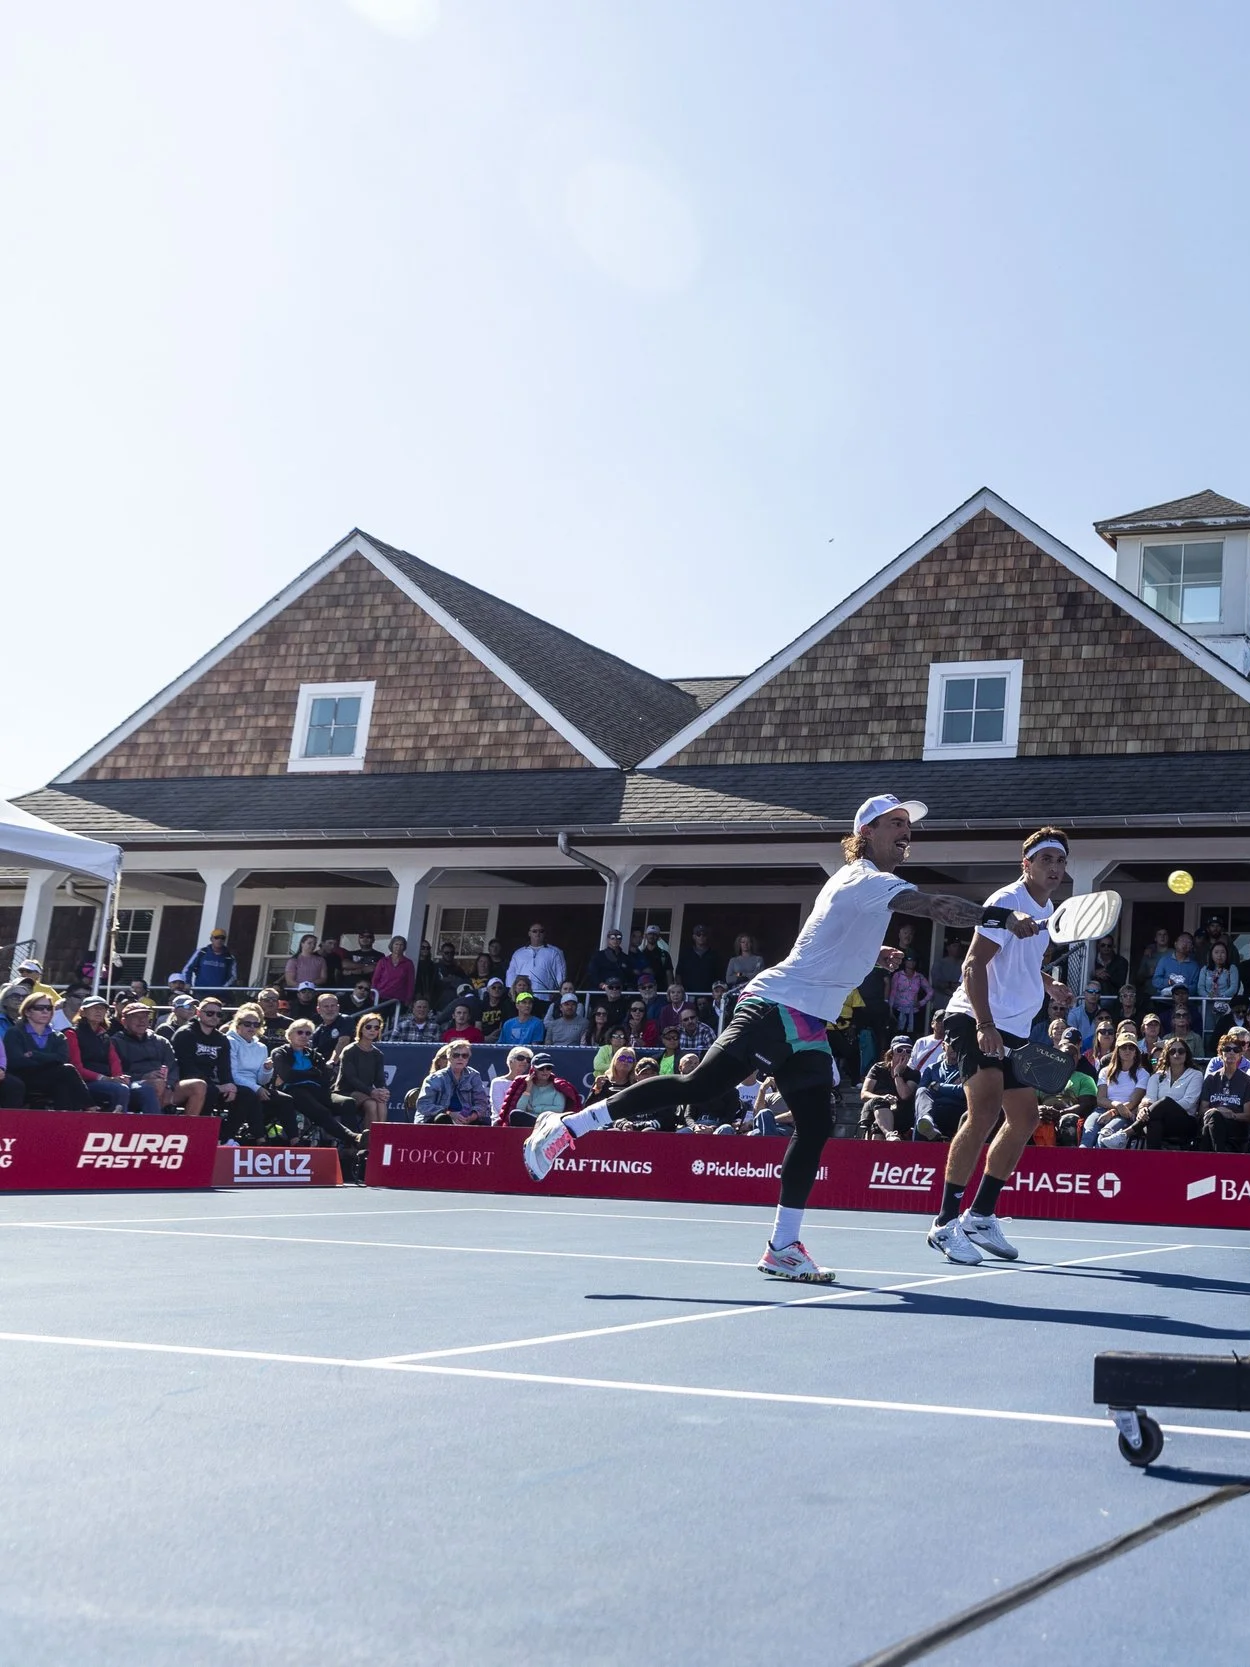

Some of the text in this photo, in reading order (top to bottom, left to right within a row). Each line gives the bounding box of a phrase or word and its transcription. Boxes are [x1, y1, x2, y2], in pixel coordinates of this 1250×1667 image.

[1036, 1047, 1067, 1064] VULCAN
[82, 1132, 189, 1153] DURA
[76, 1154, 184, 1169] FAST 40
[234, 1149, 312, 1175] Hertz
[397, 1148, 495, 1166] TOPCOURT
[553, 1158, 653, 1174] RAFTKINGS
[870, 1161, 936, 1185] Hertz
